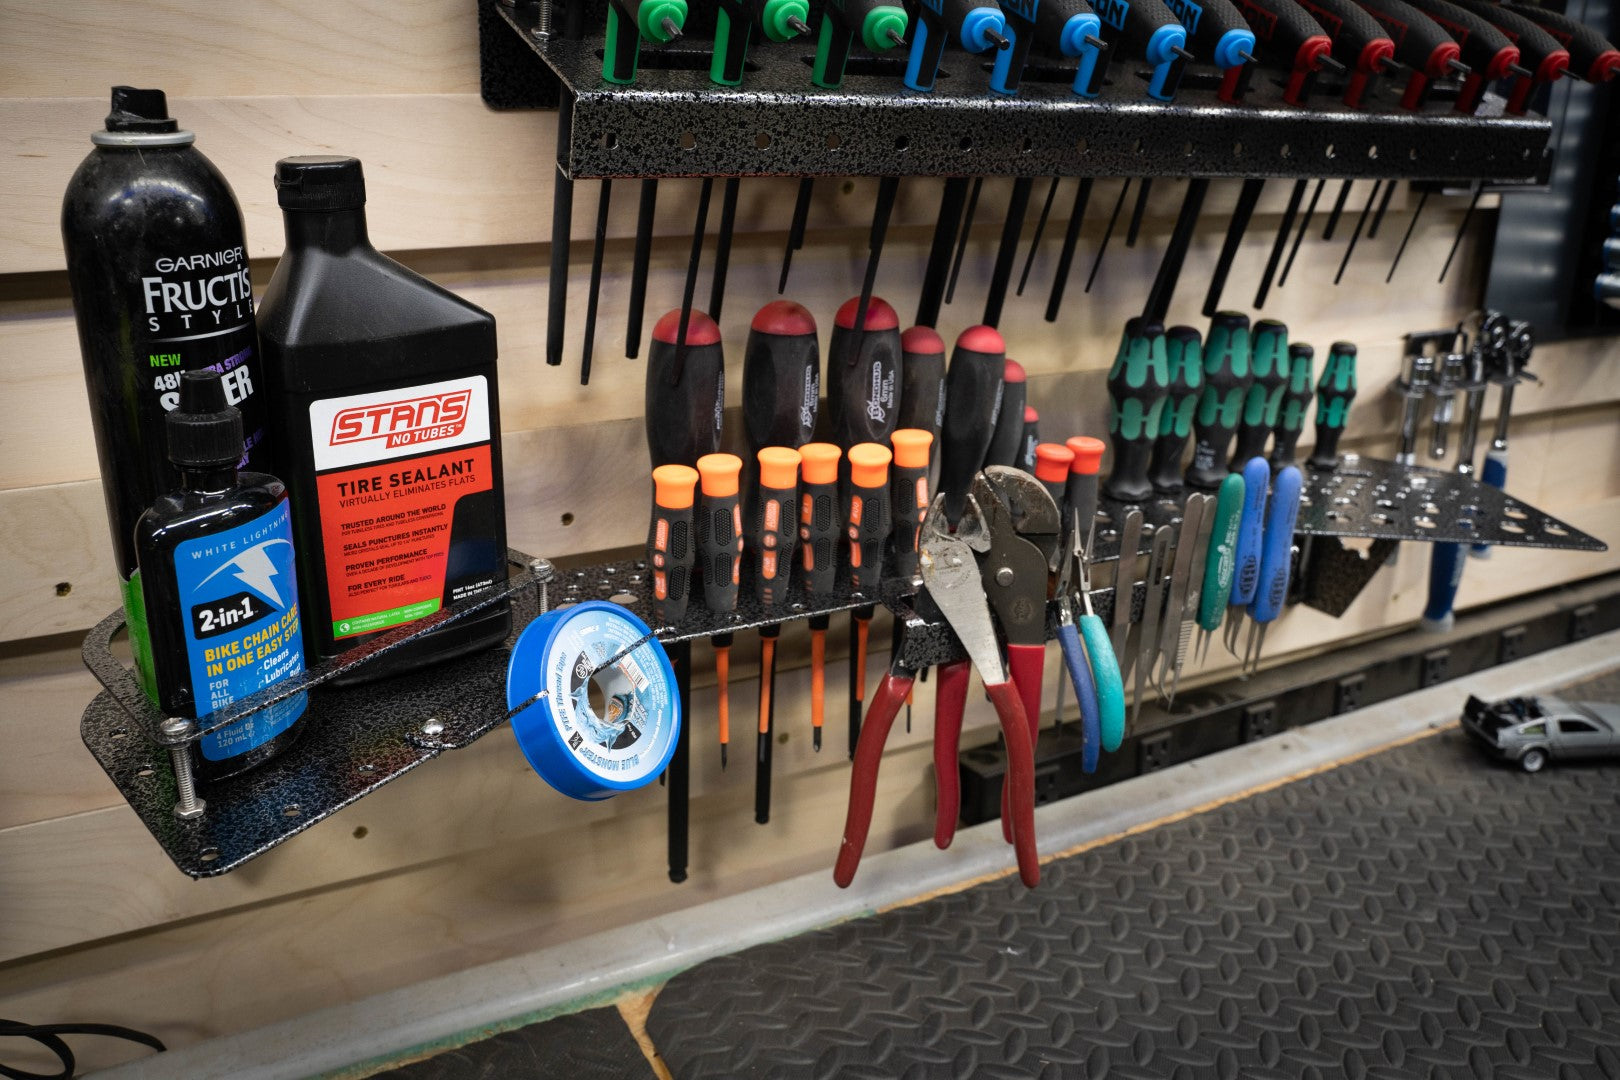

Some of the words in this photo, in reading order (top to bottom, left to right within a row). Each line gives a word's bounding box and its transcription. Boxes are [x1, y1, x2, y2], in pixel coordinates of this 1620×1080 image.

[156, 247, 243, 273] GARNIER
[142, 265, 251, 313] FRUCTIS
[149, 299, 253, 332] STYLE
[150, 353, 181, 368] NEW
[391, 433, 410, 446] NO
[413, 425, 455, 441] TUBES
[337, 476, 382, 497] TIRE
[389, 459, 475, 487] SEALANT
[339, 492, 390, 508] VIRTUALLY
[393, 480, 446, 498] ELIMINATES
[449, 475, 476, 487] FLATS
[341, 518, 374, 530] TRUSTED
[376, 512, 405, 524] AROUND
[407, 508, 420, 518] THE
[421, 503, 447, 514] WORLD
[343, 541, 367, 551] SEALS
[368, 532, 410, 546] PUNCTURES
[412, 523, 448, 537] INSTANTLY
[191, 541, 236, 560] WHITE
[345, 560, 374, 572] PROVEN
[376, 548, 428, 565] PERFORMANCE
[348, 583, 362, 592] FOR
[364, 577, 387, 588] EVERY
[388, 574, 405, 583] RIDE
[199, 596, 254, 633] 2-in-1
[205, 641, 240, 662] BIKE
[243, 621, 279, 650] CHAIN
[281, 602, 298, 629] CARE
[206, 662, 223, 678] IN
[226, 651, 254, 672] ONE
[257, 635, 283, 659] EASY
[284, 617, 299, 642] STEP
[263, 648, 289, 671] Cleans
[264, 651, 299, 684] Lubricates
[209, 678, 229, 691] FOR
[211, 688, 230, 701] ALL
[218, 738, 234, 748] 120
[224, 725, 244, 738] Fluid
